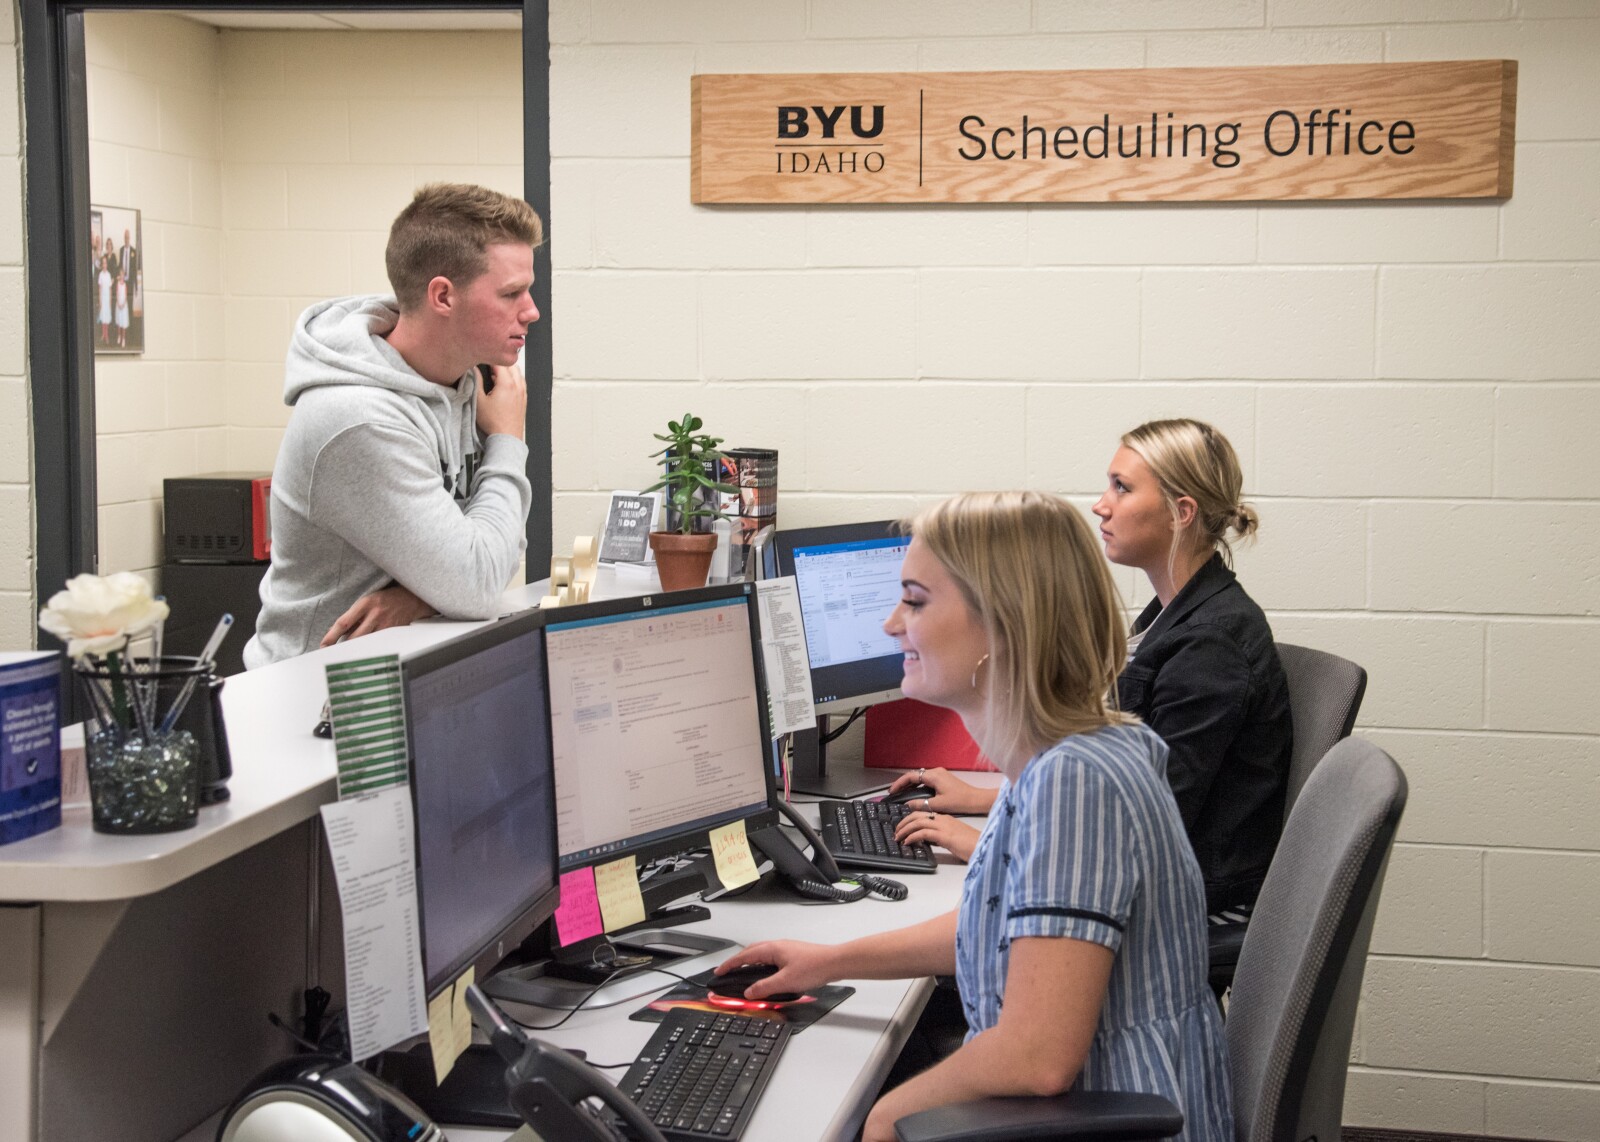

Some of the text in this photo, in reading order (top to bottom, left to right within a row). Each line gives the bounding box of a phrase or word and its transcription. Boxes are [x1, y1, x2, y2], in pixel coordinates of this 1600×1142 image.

[777, 105, 886, 139] BYU
[957, 108, 1416, 169] Scheduling Office
[777, 151, 885, 174] IDAHO
[617, 500, 641, 510] FIND
[623, 519, 637, 528] DO
